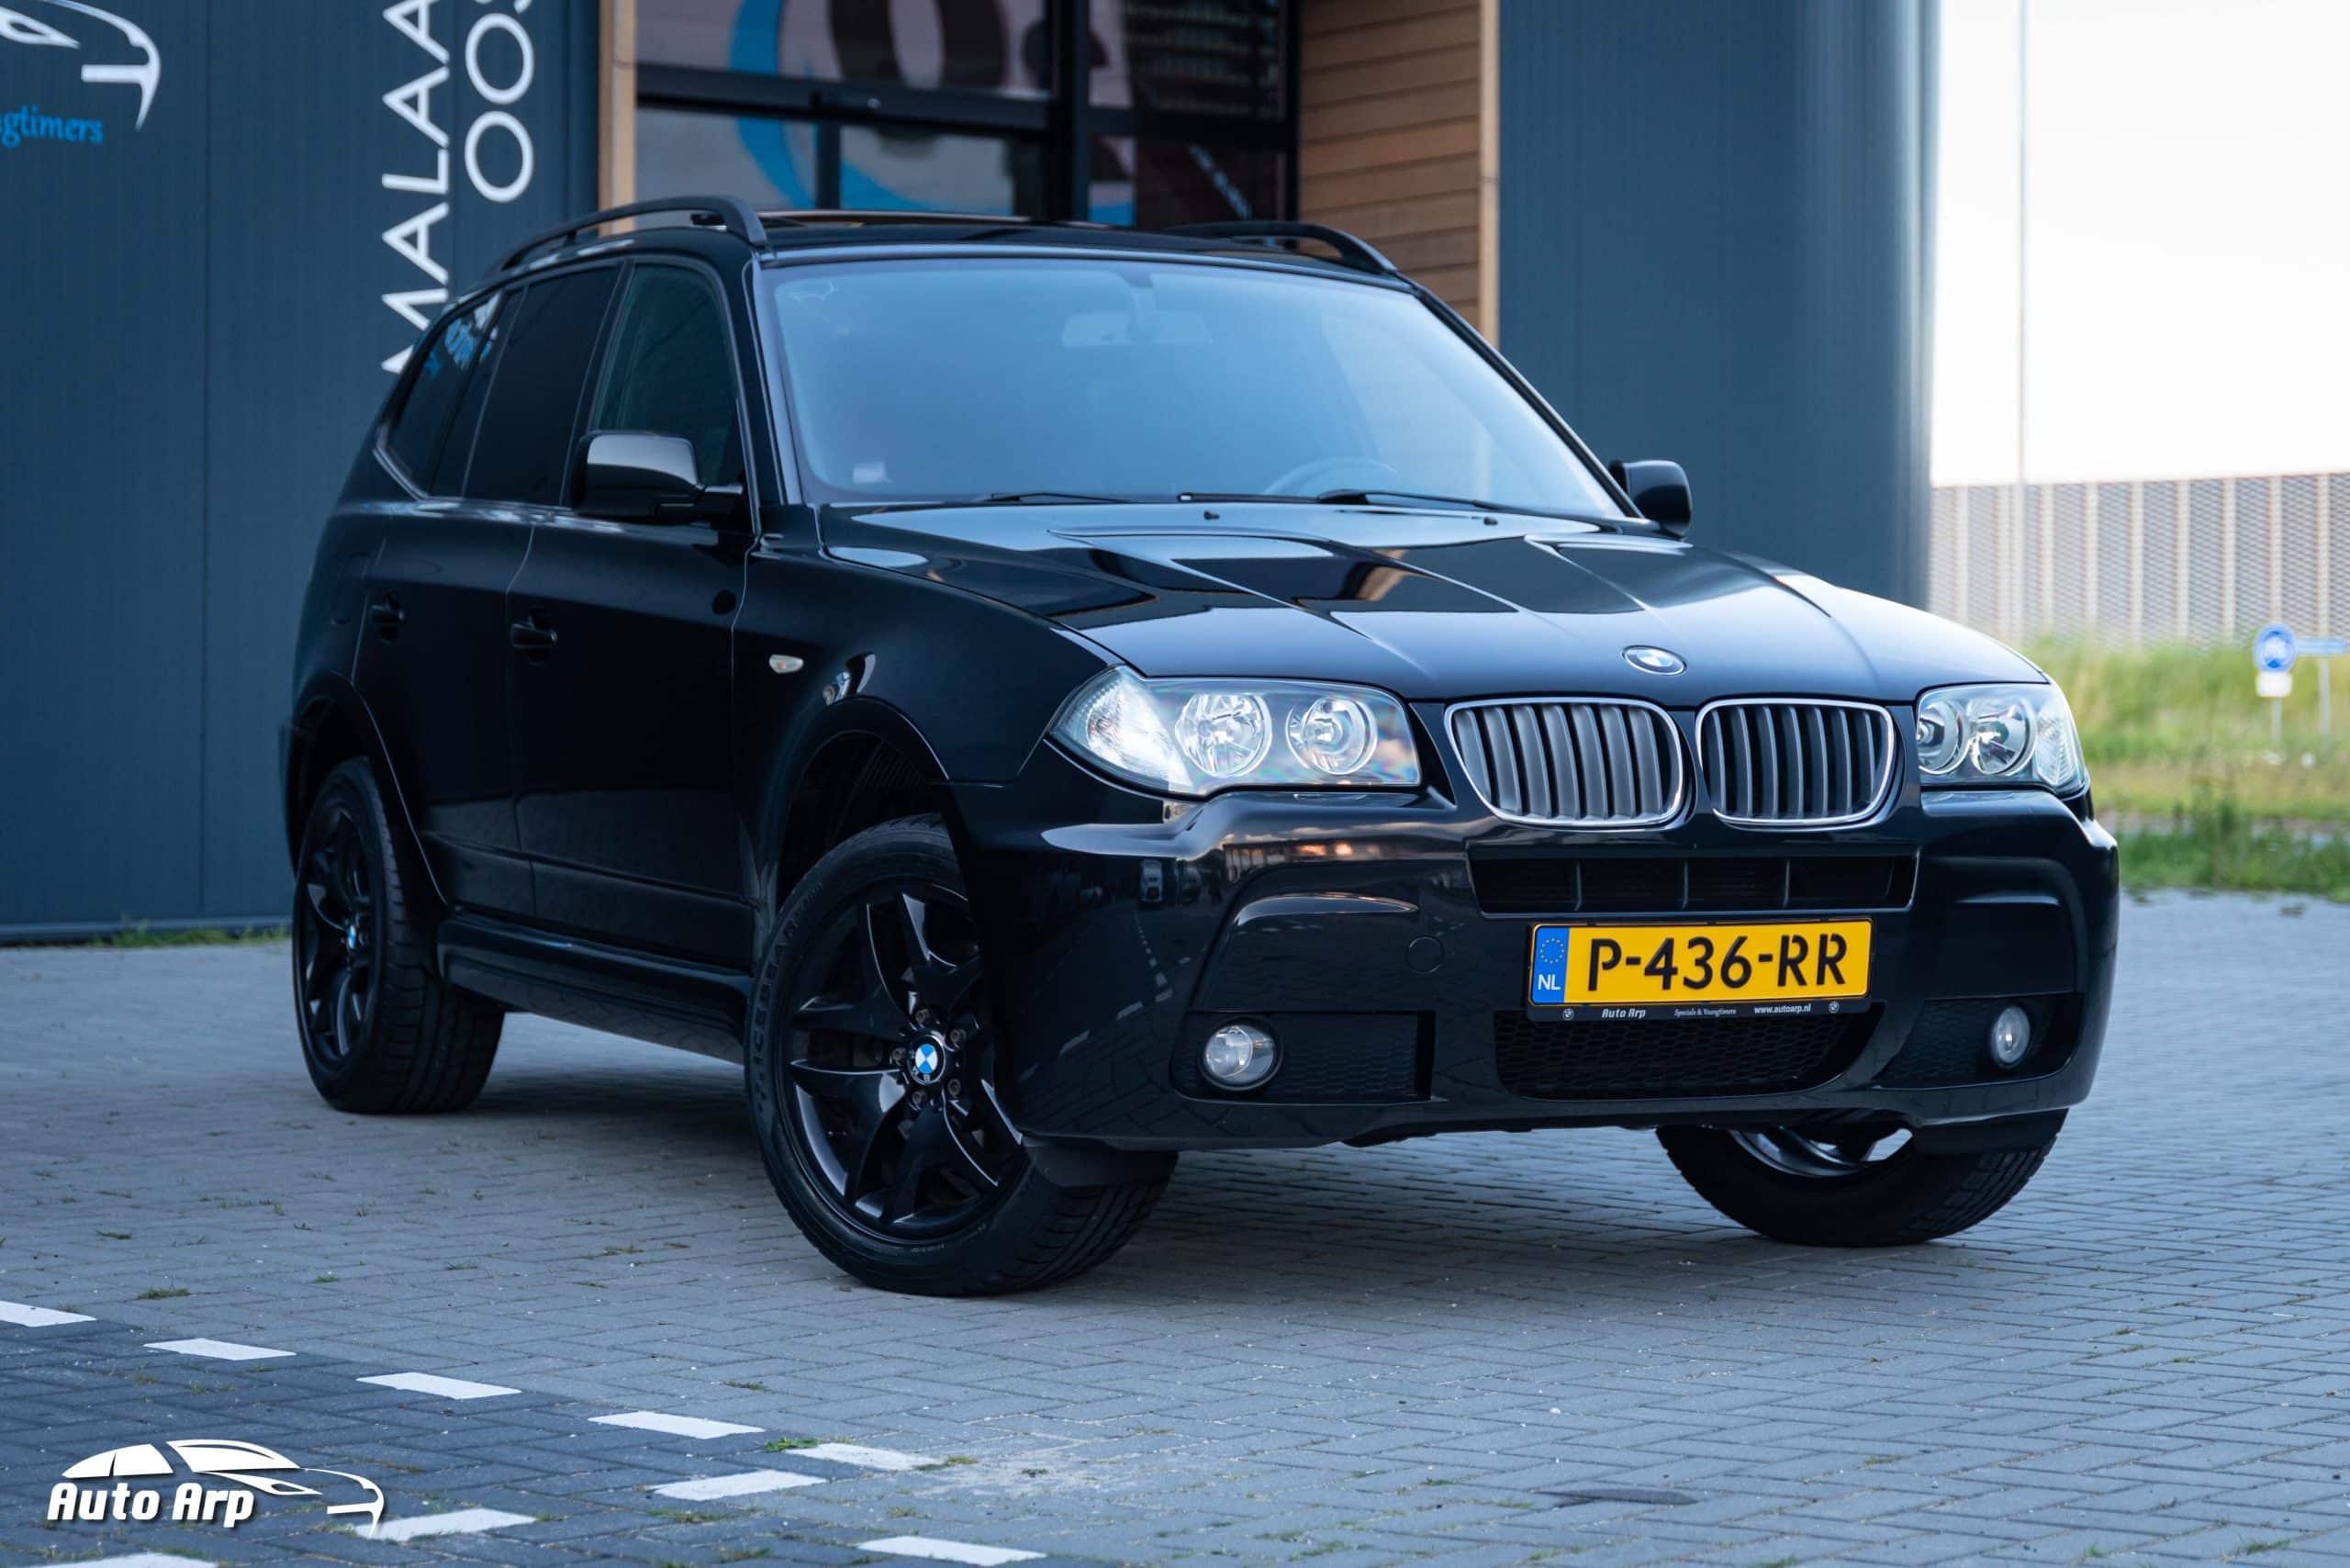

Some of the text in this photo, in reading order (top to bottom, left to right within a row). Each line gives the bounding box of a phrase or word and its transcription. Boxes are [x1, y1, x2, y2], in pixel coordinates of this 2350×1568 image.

[464, 0, 534, 204] OO
[0, 105, 104, 150] gtimers
[1587, 933, 1848, 991] P-436-RR
[1538, 974, 1561, 991] NL
[1601, 1009, 1647, 1020] Auto Arp
[1754, 1002, 1812, 1015] www.autoarp.nl
